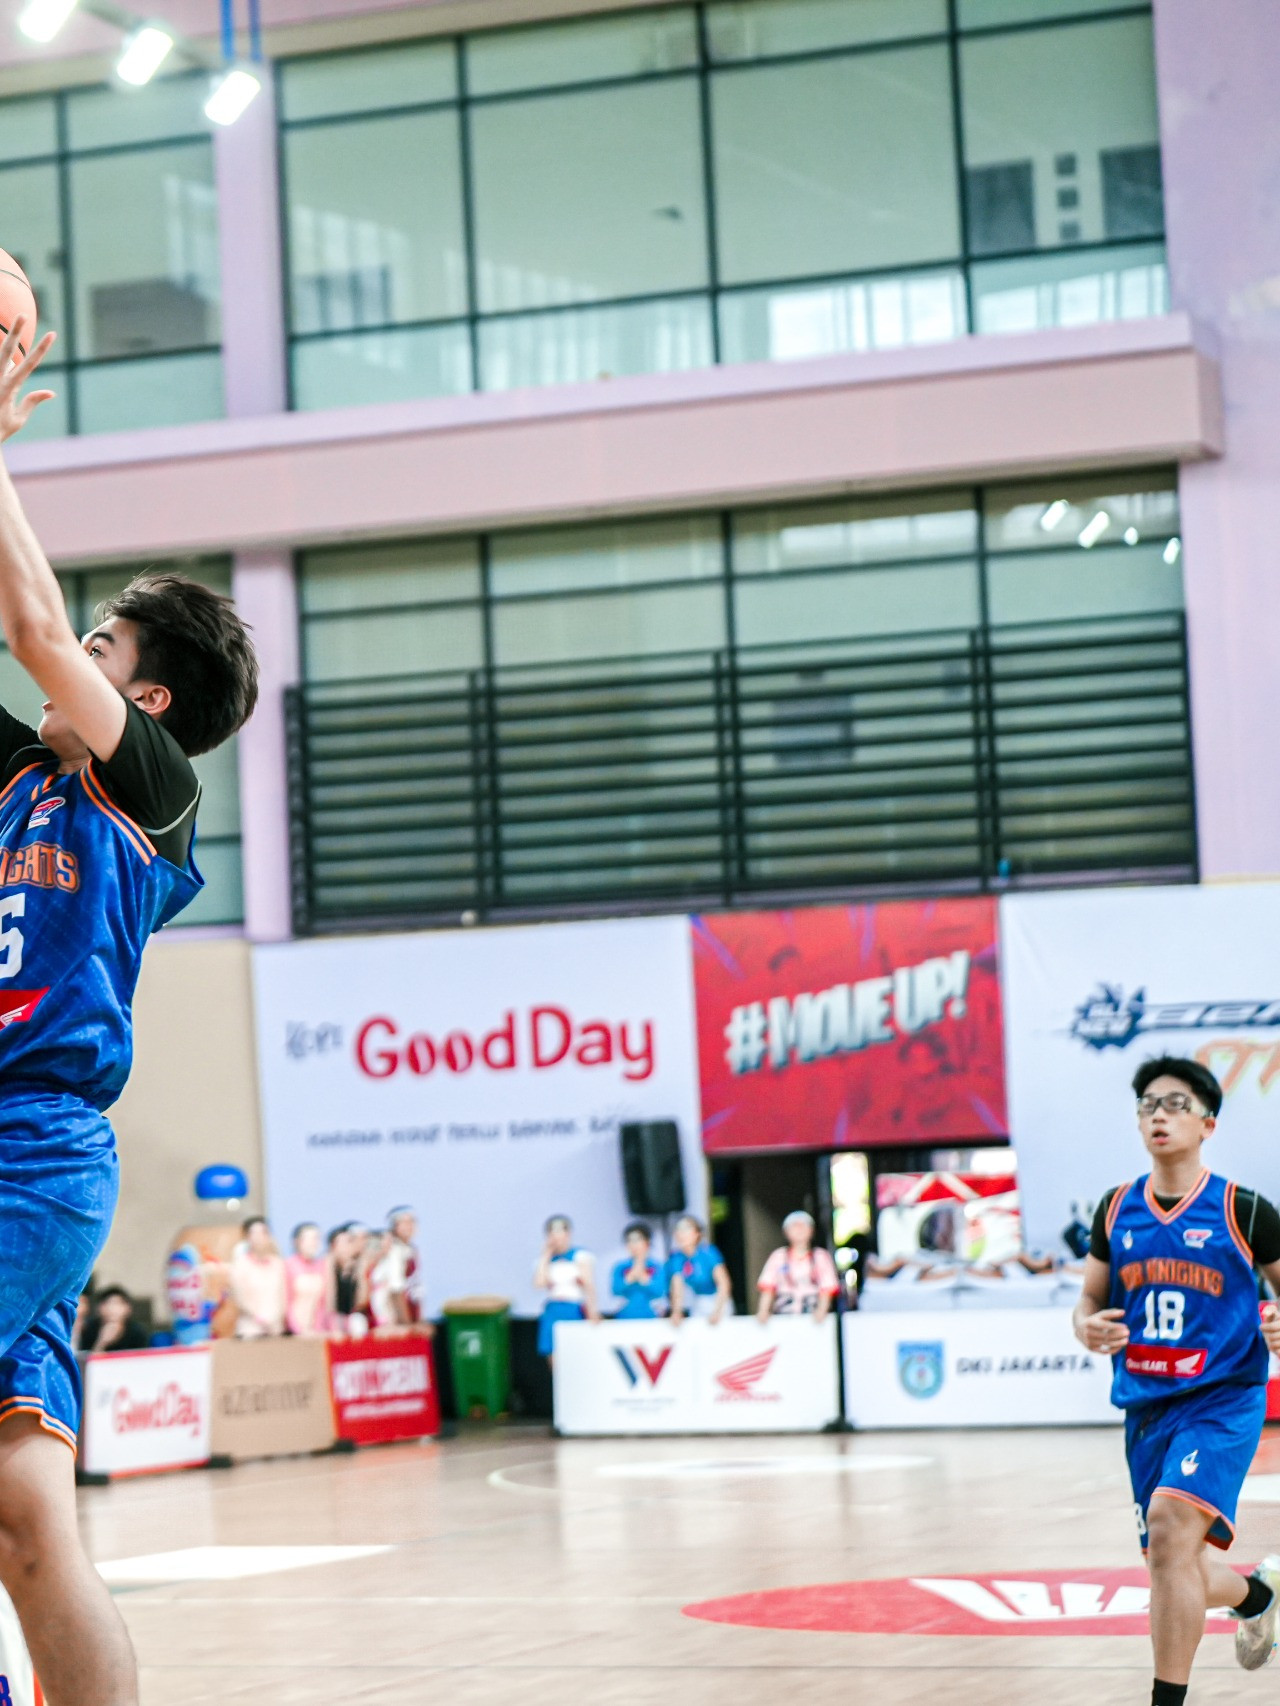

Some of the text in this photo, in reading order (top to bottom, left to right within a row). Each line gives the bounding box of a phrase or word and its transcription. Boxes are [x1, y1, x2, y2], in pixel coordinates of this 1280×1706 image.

[1145, 1257, 1224, 1297] KNIGHTS
[1142, 1289, 1186, 1340] 18
[998, 1354, 1094, 1375] JAKARTA
